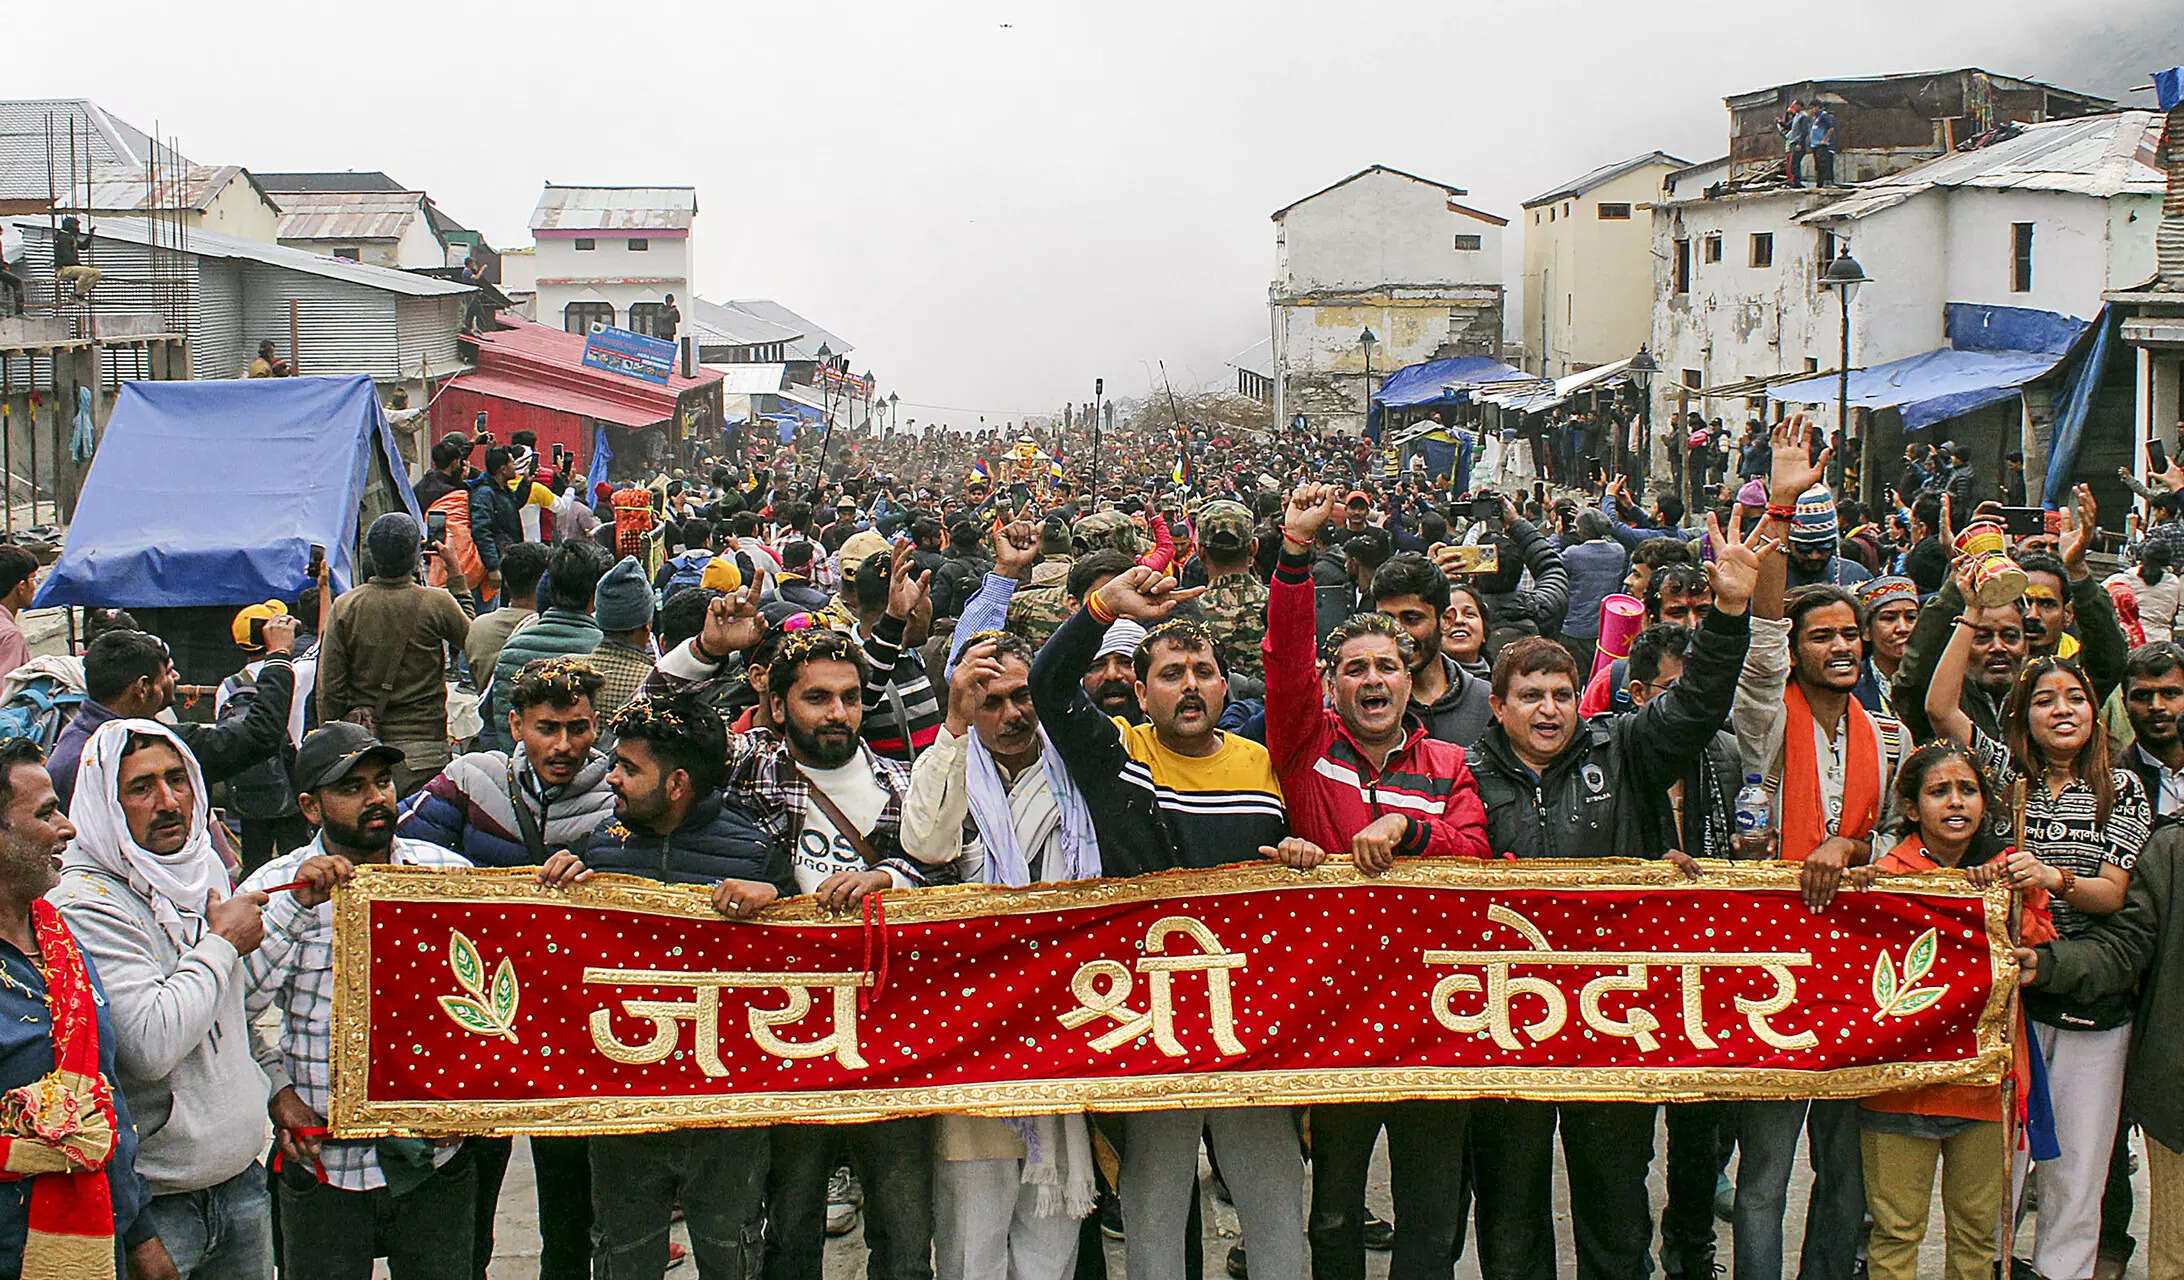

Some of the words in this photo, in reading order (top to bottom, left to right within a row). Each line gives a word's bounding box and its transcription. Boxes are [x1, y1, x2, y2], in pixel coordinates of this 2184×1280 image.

[583, 966, 875, 1078] जय
[1056, 915, 1248, 1057] श्री
[1422, 903, 1819, 1053] केदार
